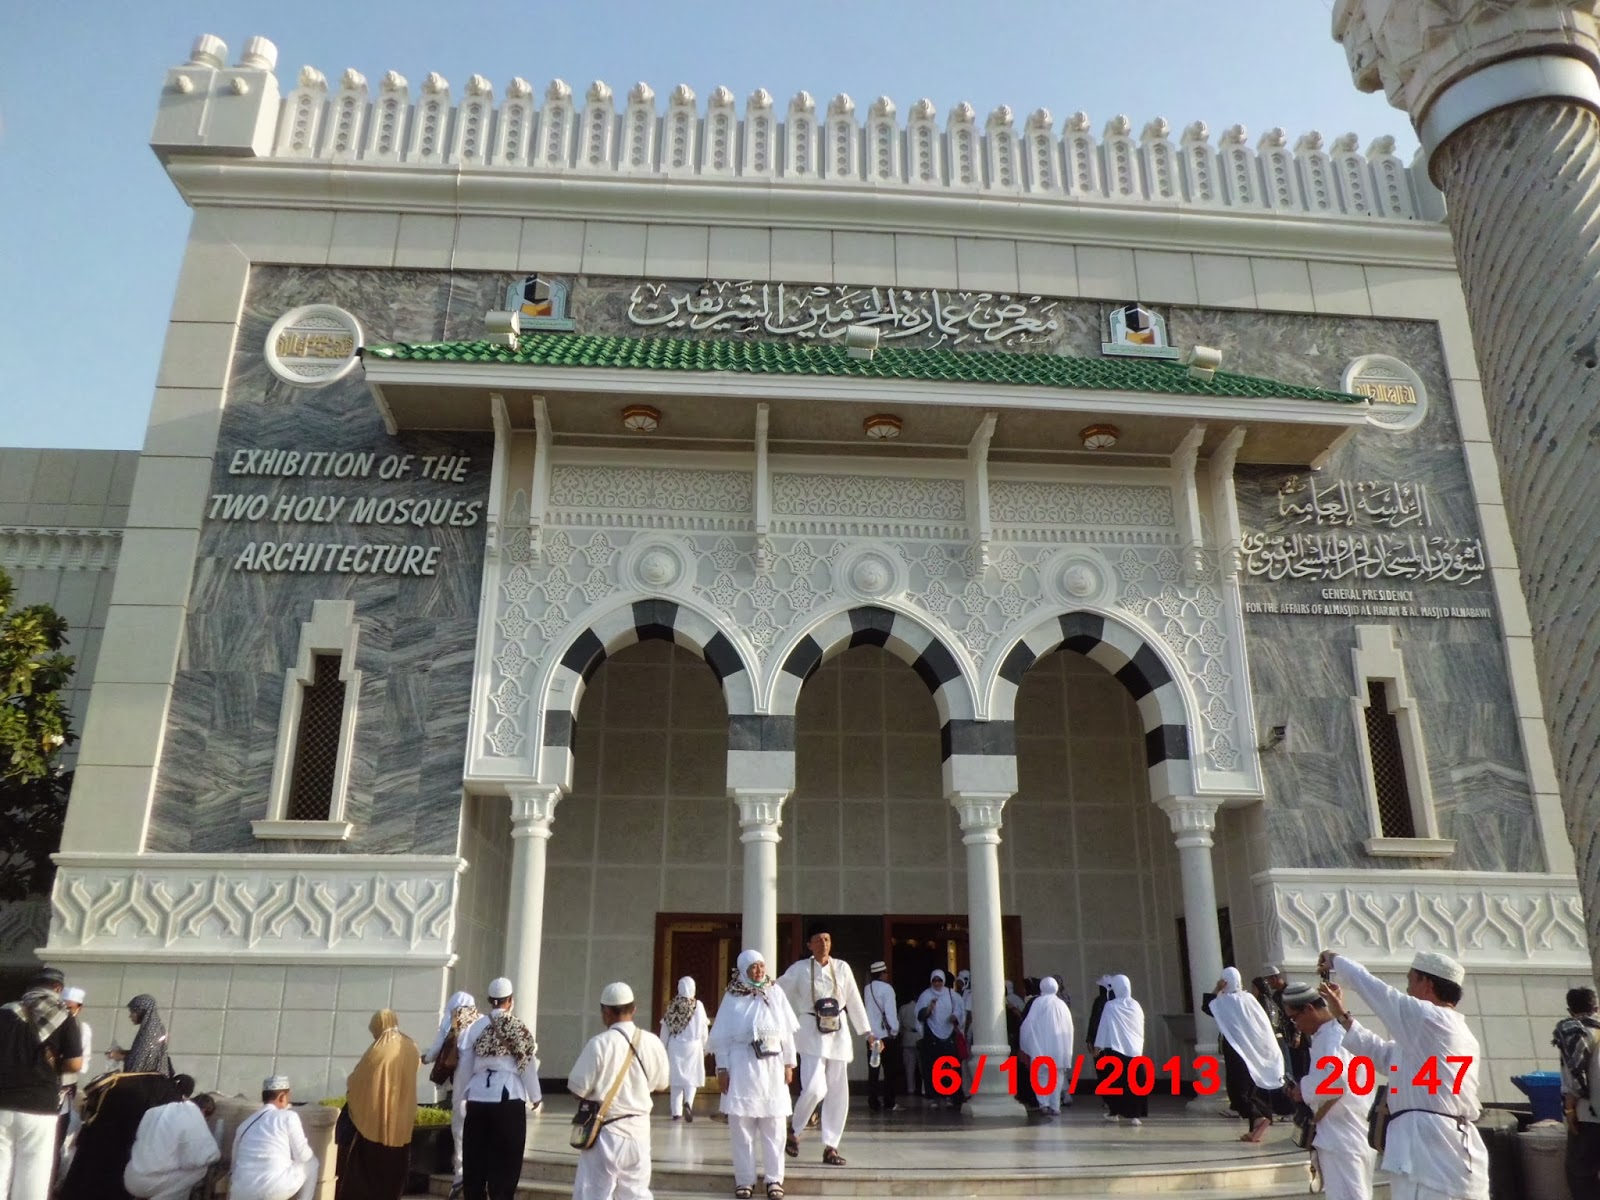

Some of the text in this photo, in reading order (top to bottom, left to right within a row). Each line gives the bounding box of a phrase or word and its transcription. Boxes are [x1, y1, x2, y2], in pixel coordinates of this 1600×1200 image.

[228, 449, 471, 483] EXHIBITION OF THE
[208, 494, 483, 527] TWO HOLY MOSQUES
[234, 541, 441, 576] ARCHITECTURE
[1246, 602, 1261, 613] FOR
[1262, 602, 1279, 613] THE
[1280, 603, 1310, 614] AFFAIRS
[1311, 604, 1322, 615] OF
[1373, 605, 1400, 616] HARAM
[1401, 606, 1408, 616] &
[1321, 588, 1413, 602] GENERAL PRESIDENCY
